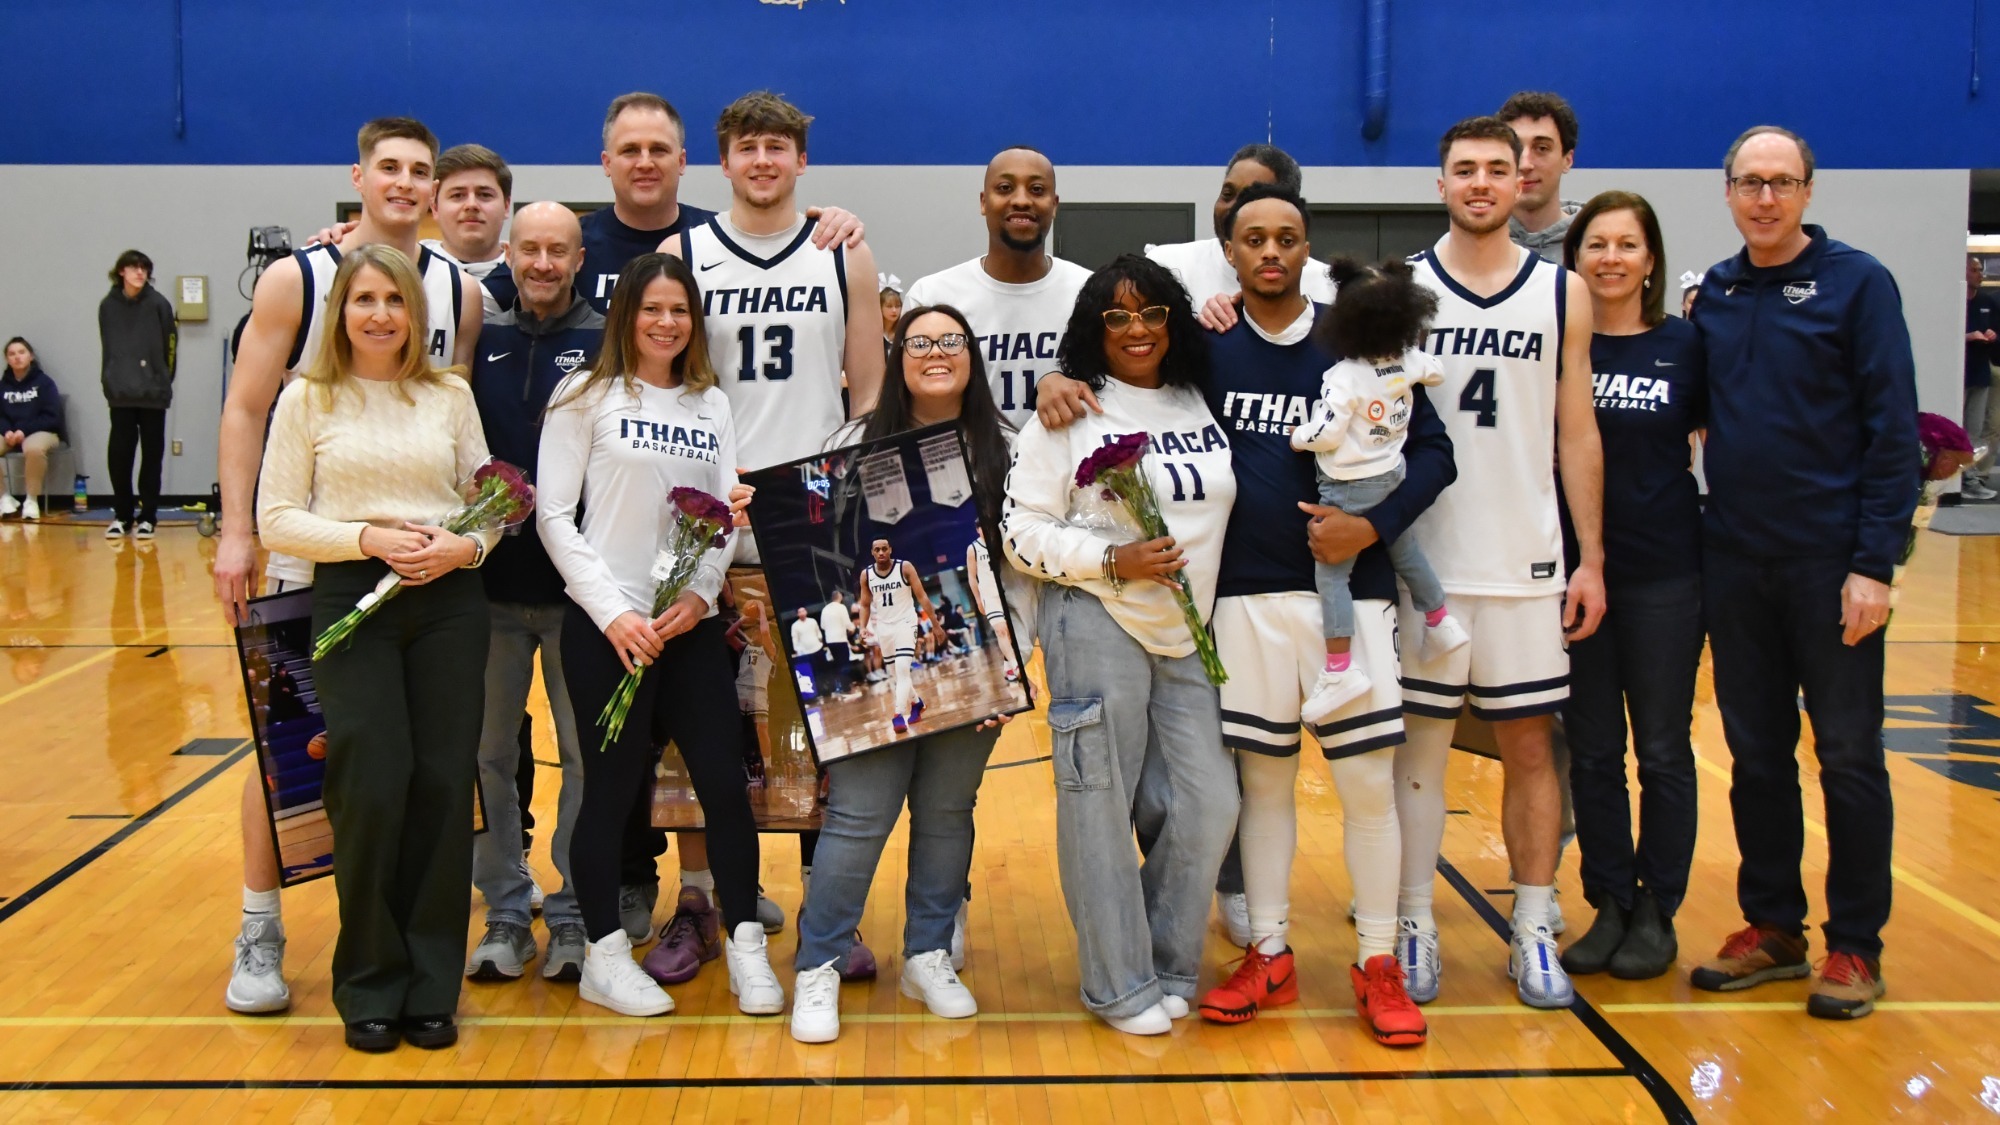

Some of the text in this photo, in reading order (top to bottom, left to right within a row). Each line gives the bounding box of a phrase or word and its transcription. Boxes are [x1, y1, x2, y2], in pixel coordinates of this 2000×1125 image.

[704, 286, 828, 316] ITHACA
[737, 323, 795, 383] 13
[1001, 370, 1035, 410] 11
[1458, 367, 1499, 430] 4
[620, 418, 720, 456] ITHACA
[632, 439, 717, 465] BASKETBALL
[1163, 463, 1206, 501] 11
[871, 581, 902, 593] ITHACA
[882, 592, 894, 607] 11
